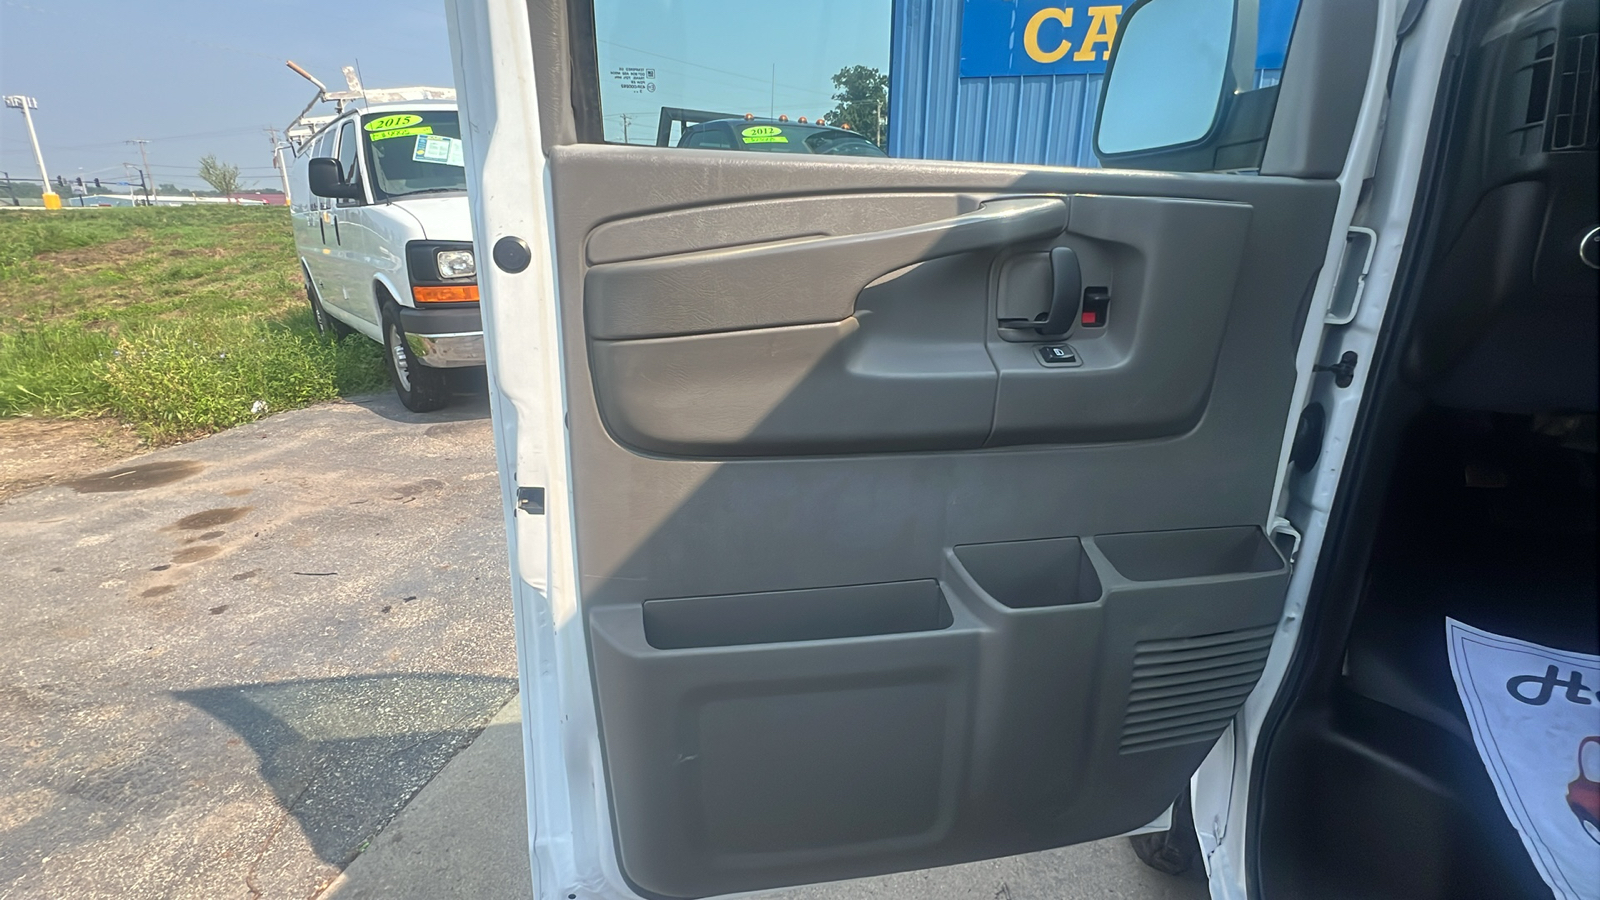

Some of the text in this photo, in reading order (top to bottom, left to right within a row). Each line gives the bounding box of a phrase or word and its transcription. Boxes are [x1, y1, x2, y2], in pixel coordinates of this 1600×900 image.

[376, 116, 411, 129] 2015
[751, 127, 775, 136] 2012
[1506, 664, 1600, 706] H
